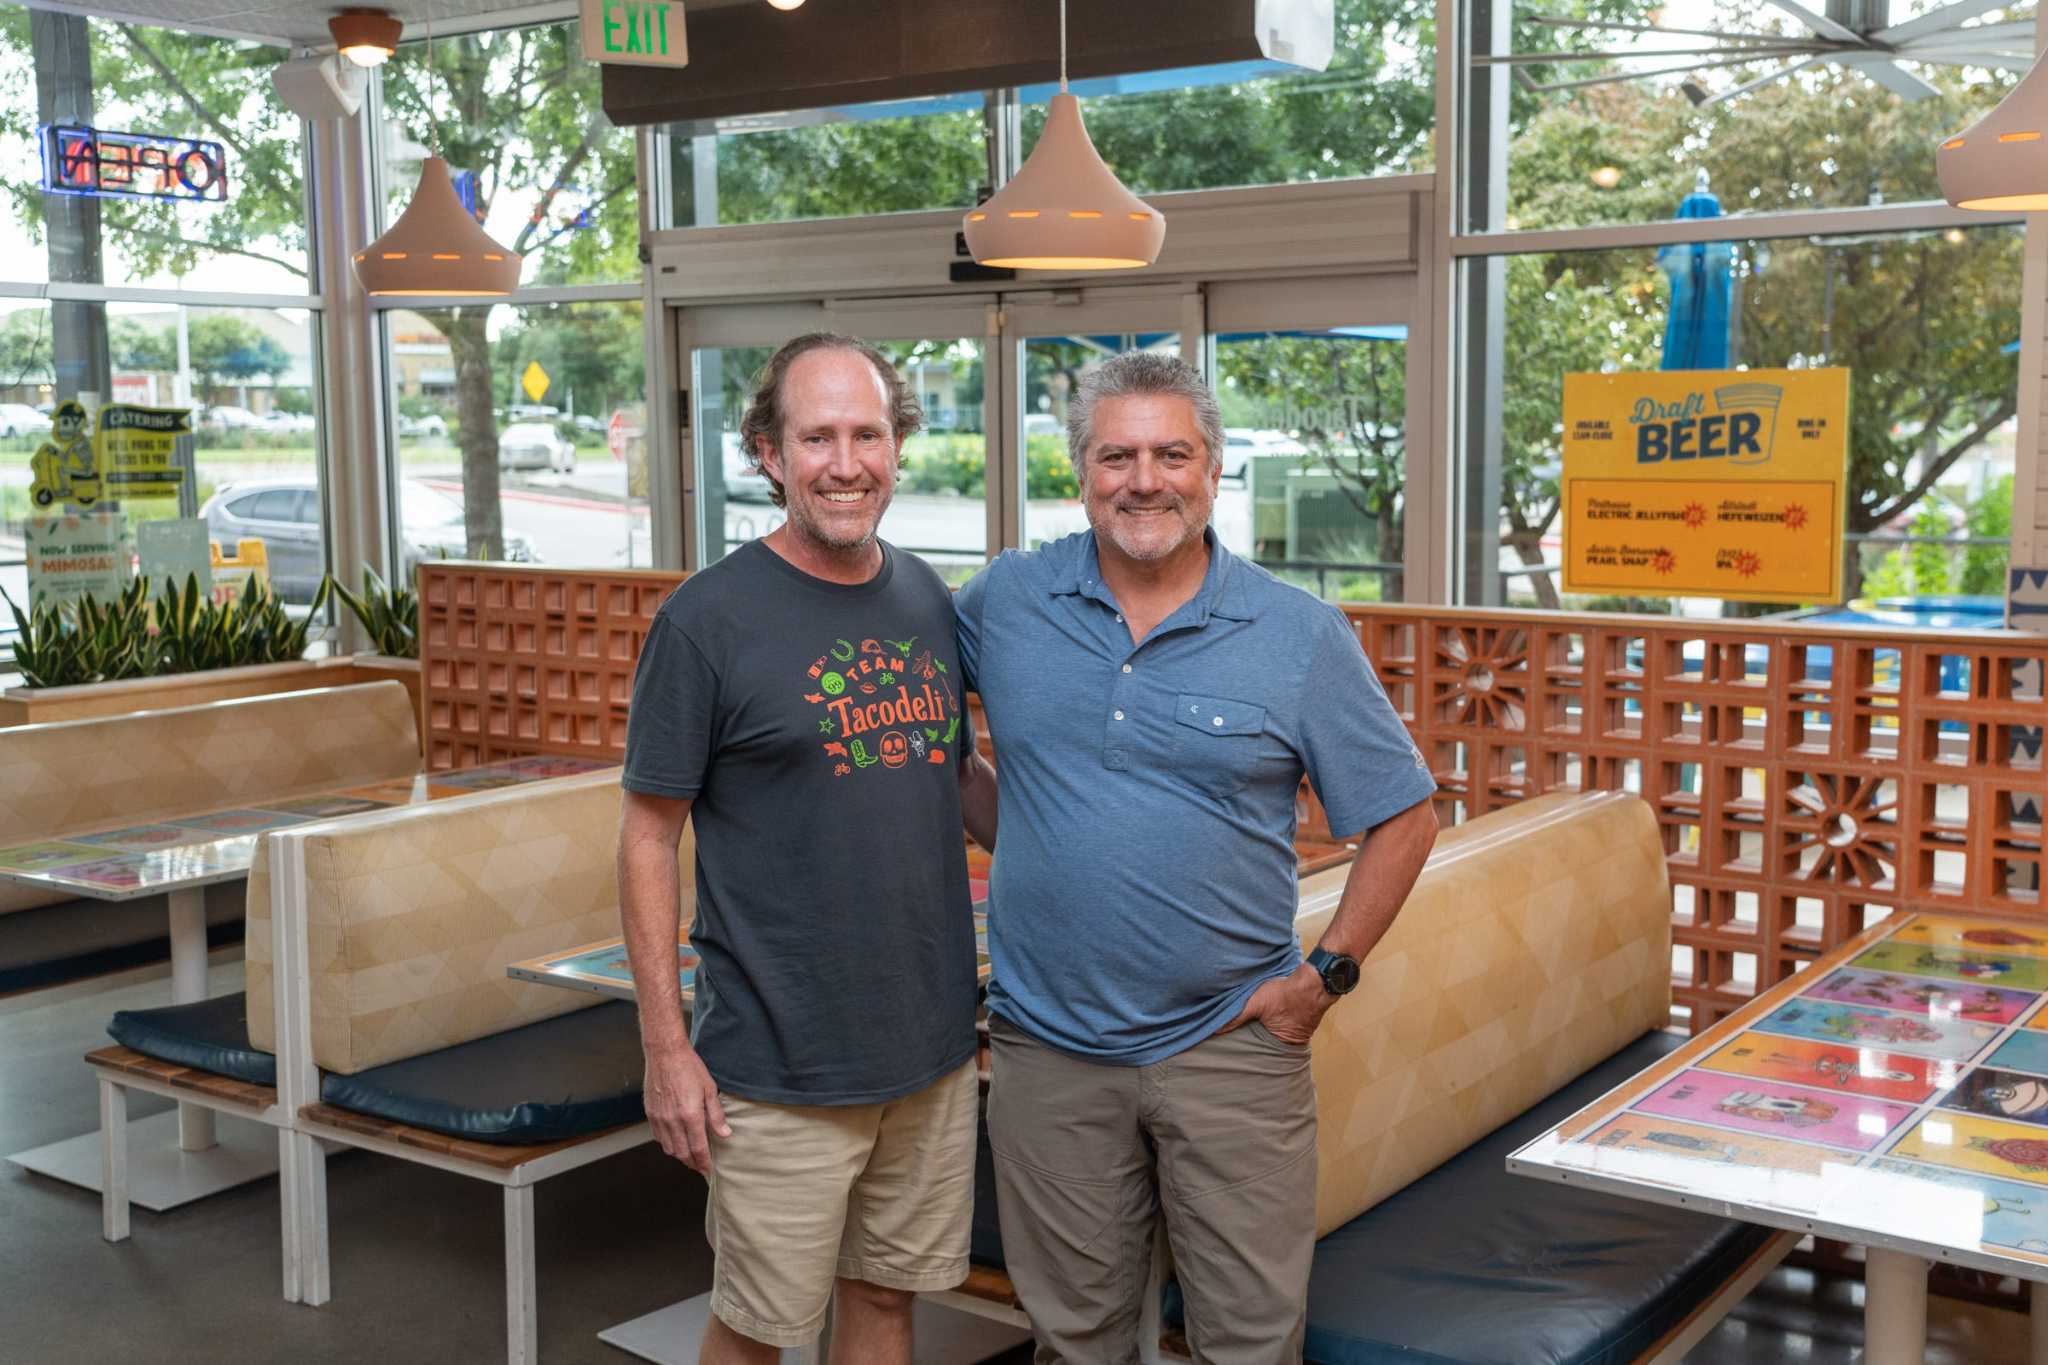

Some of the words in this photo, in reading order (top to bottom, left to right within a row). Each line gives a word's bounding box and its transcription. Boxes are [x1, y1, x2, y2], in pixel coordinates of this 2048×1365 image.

[603, 0, 671, 55] EXIT
[1628, 391, 1705, 425] Draft
[110, 411, 174, 428] CATERING
[1637, 411, 1761, 464] BEER
[1587, 510, 1632, 520] ELECTRIC
[1717, 512, 1786, 522] HEFEWEIZEN
[40, 545, 67, 556] NOW
[42, 556, 115, 574] MIMOSAS
[1586, 555, 1618, 566] PEARL
[1621, 556, 1649, 567] SNAP
[1716, 559, 1733, 569] IPA
[846, 656, 905, 681] TEAM
[827, 684, 945, 737] Tacodeli
